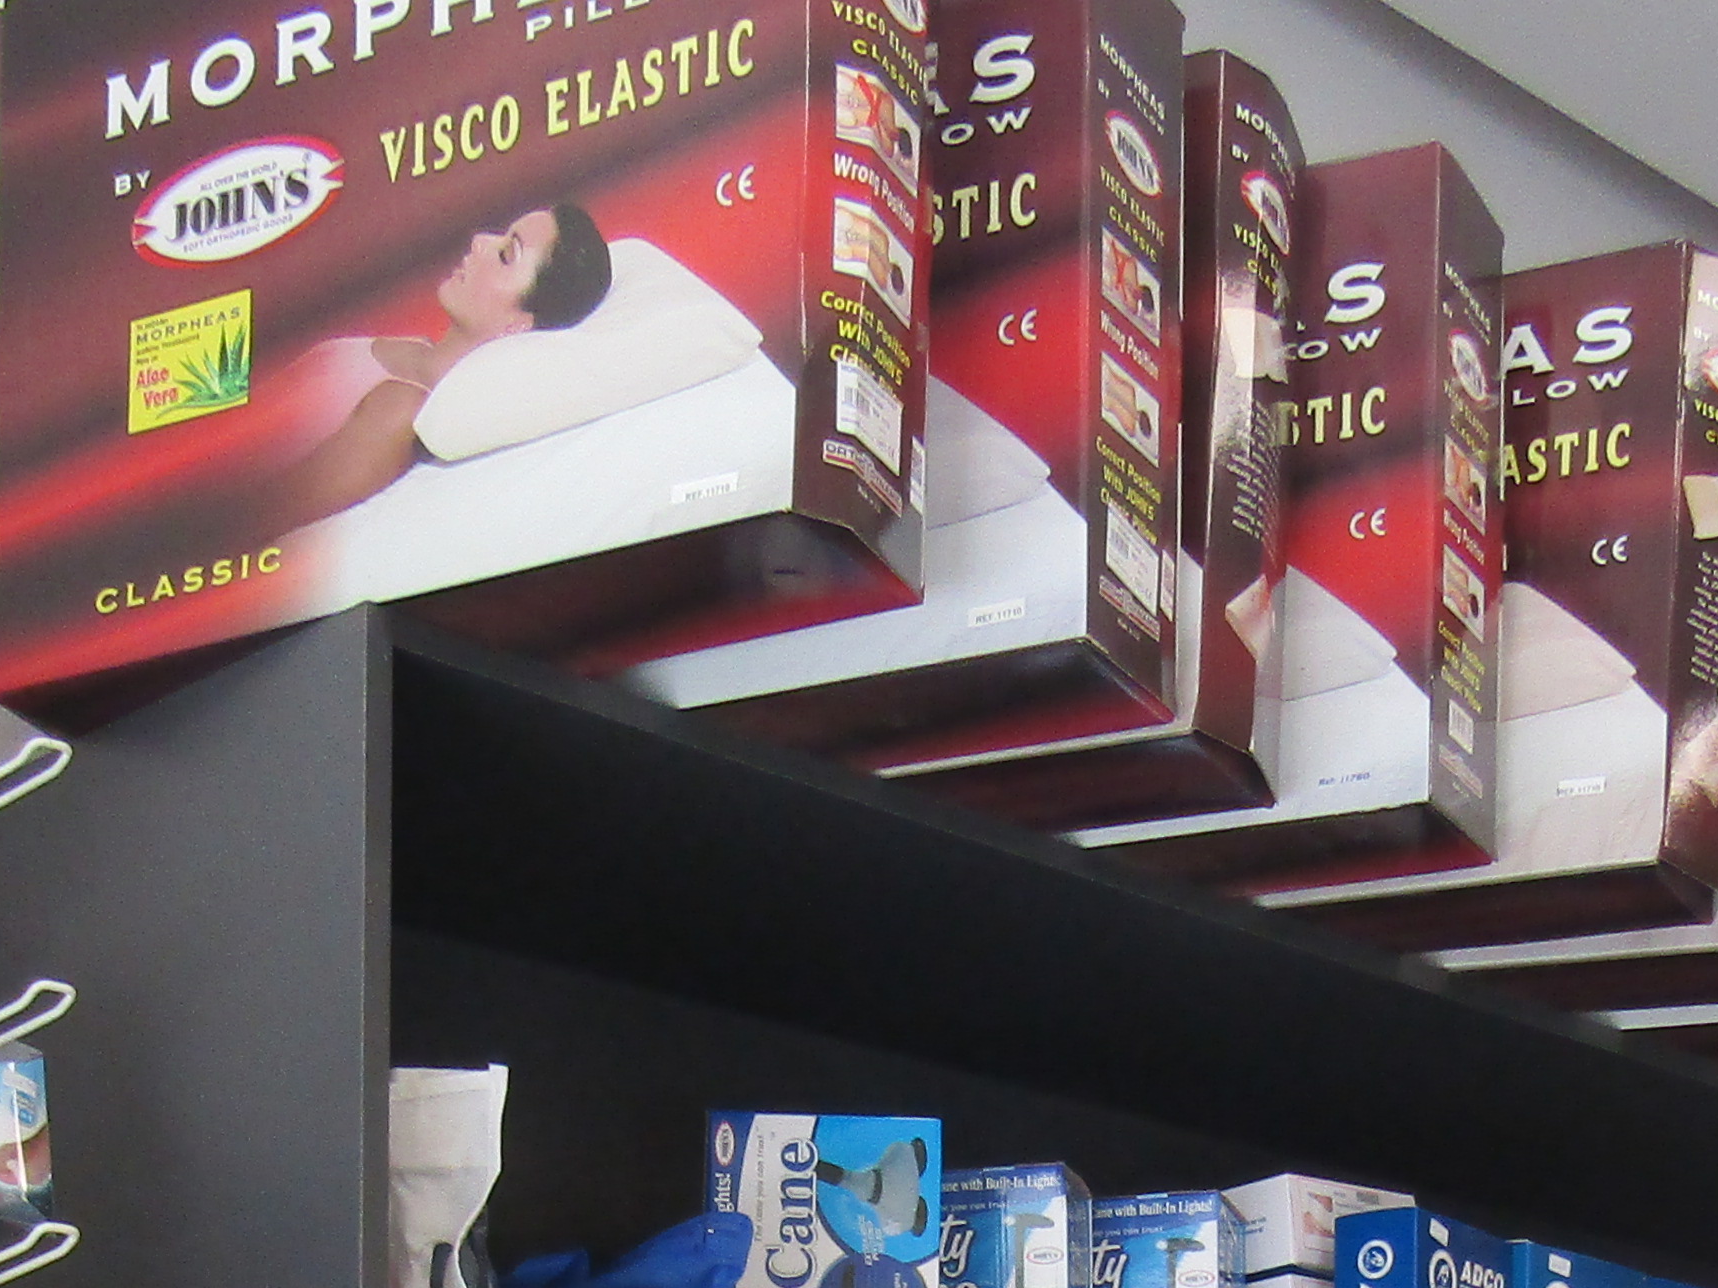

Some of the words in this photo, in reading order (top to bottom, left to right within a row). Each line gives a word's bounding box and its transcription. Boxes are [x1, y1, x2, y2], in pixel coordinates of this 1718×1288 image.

[833, 3, 886, 36] VISCO
[104, 0, 517, 139] MORPH
[851, 38, 919, 105] CLASSIC
[1098, 33, 1166, 121] MORPHEAS
[379, 94, 521, 182] VISCO
[545, 18, 757, 137] ELASTIC
[114, 169, 152, 197] BY
[165, 165, 313, 242] JOHN'S
[834, 151, 882, 196] Wrong
[882, 184, 915, 235] Position
[1099, 165, 1128, 208] VISCO
[1108, 206, 1158, 264] CLASSIC
[136, 306, 241, 346] MORPHEAS
[820, 289, 875, 329] Correct
[136, 366, 170, 391] Aloe
[143, 386, 179, 411] Vera
[95, 546, 283, 616] CLASSIC
[958, 1180, 982, 1193] with
[1115, 1208, 1136, 1219] with
